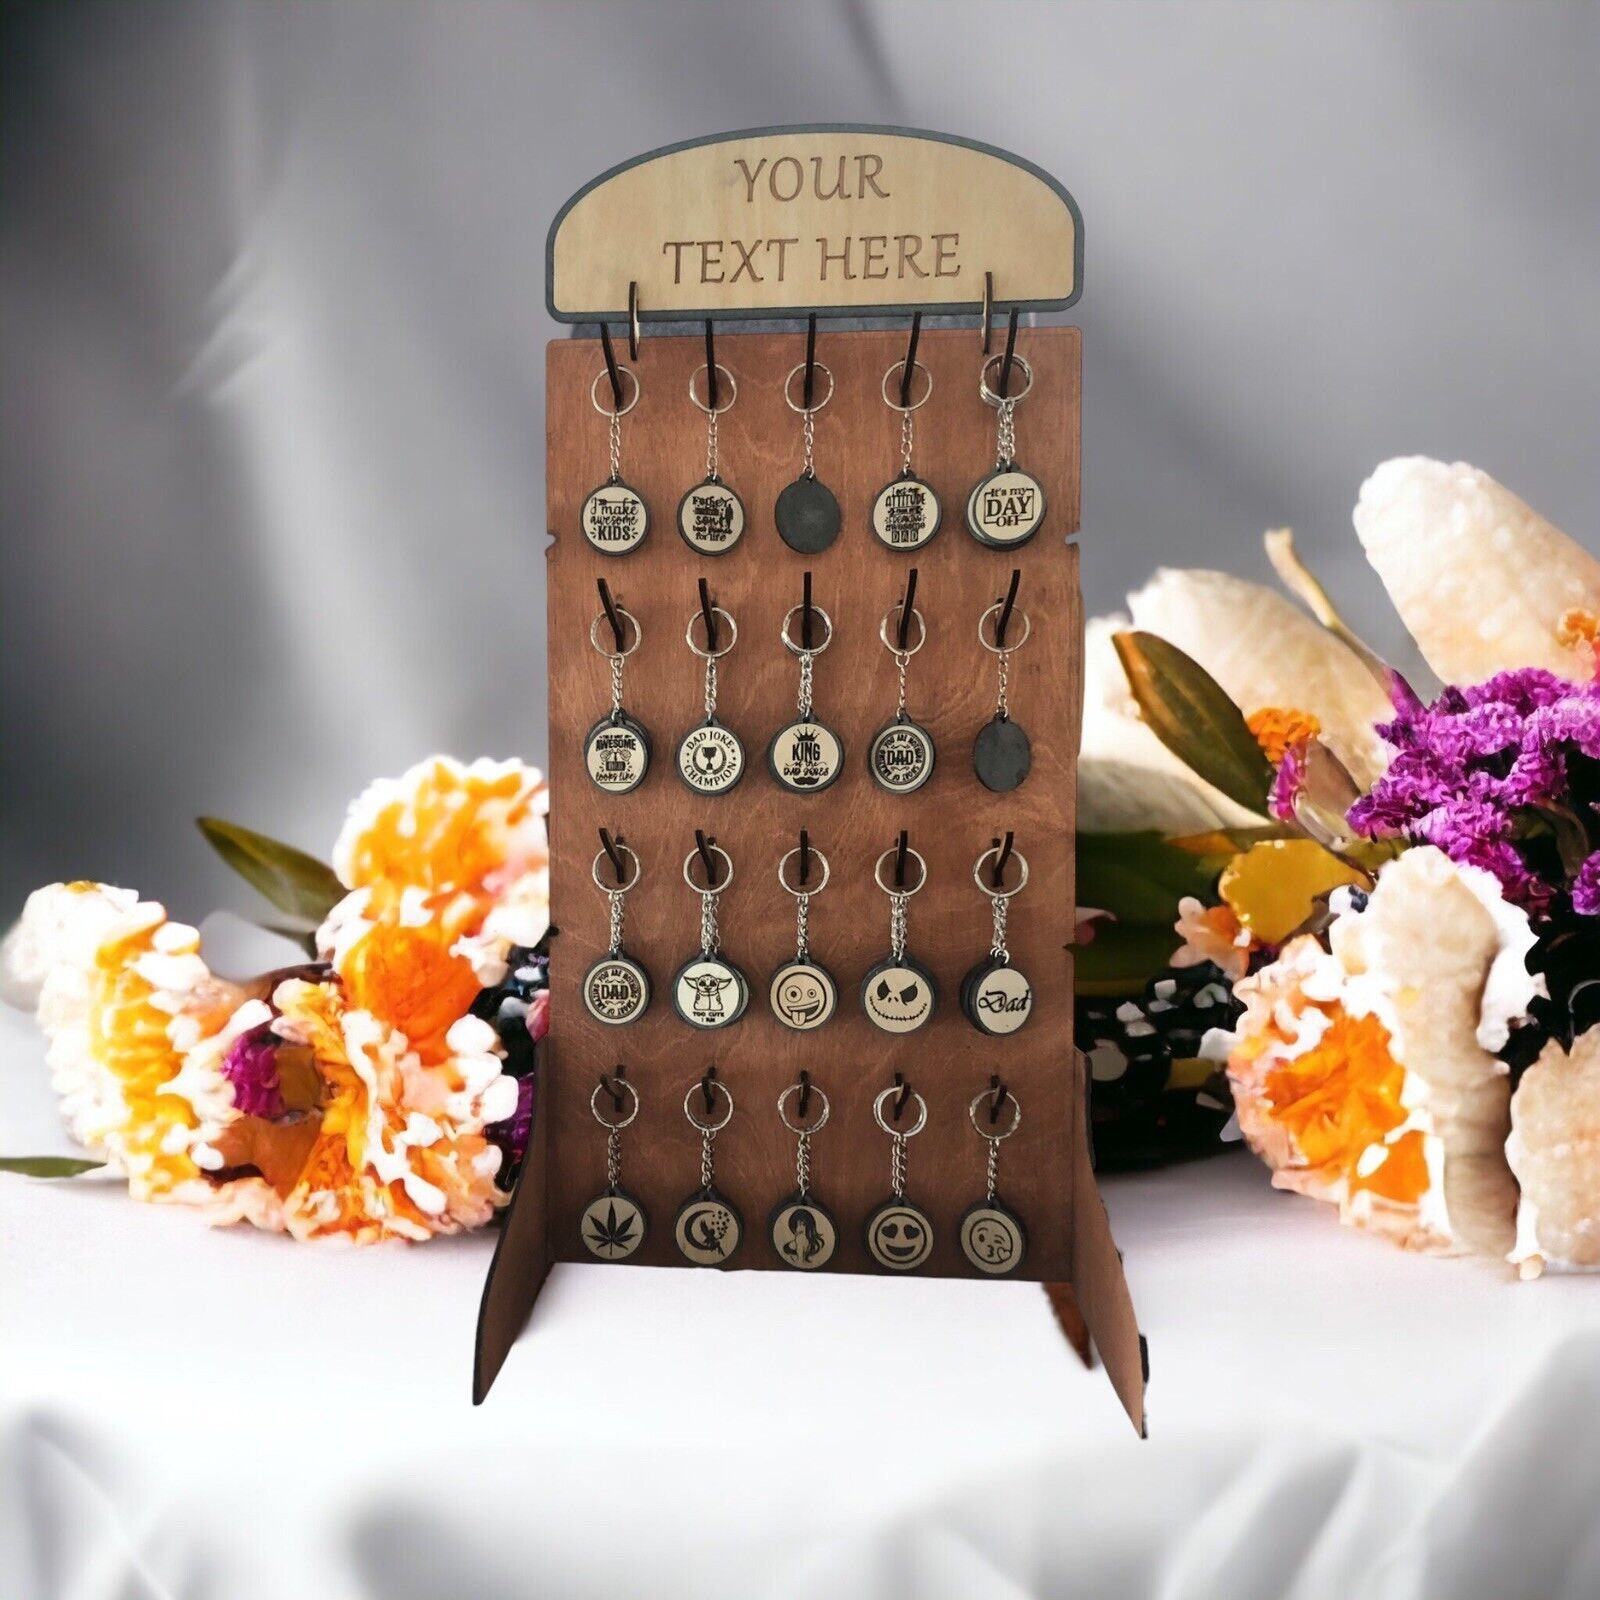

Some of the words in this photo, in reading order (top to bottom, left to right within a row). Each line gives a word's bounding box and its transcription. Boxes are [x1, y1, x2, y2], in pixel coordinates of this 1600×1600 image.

[733, 154, 890, 203] YOUR
[663, 237, 799, 284] TEXT
[816, 233, 962, 280] HERE
[1009, 487, 1027, 495] my
[601, 498, 639, 515] make
[987, 496, 1032, 517] DAY
[590, 515, 638, 526] awesome
[598, 525, 631, 541] KIDS
[596, 738, 637, 752] AWESOME
[686, 732, 707, 750] DAD
[709, 731, 735, 748] JOKE
[792, 742, 821, 762] KING
[887, 750, 914, 765] DAD
[684, 761, 737, 786] CHAMPION
[601, 985, 629, 999] DAD
[978, 990, 1029, 1013] Dad
